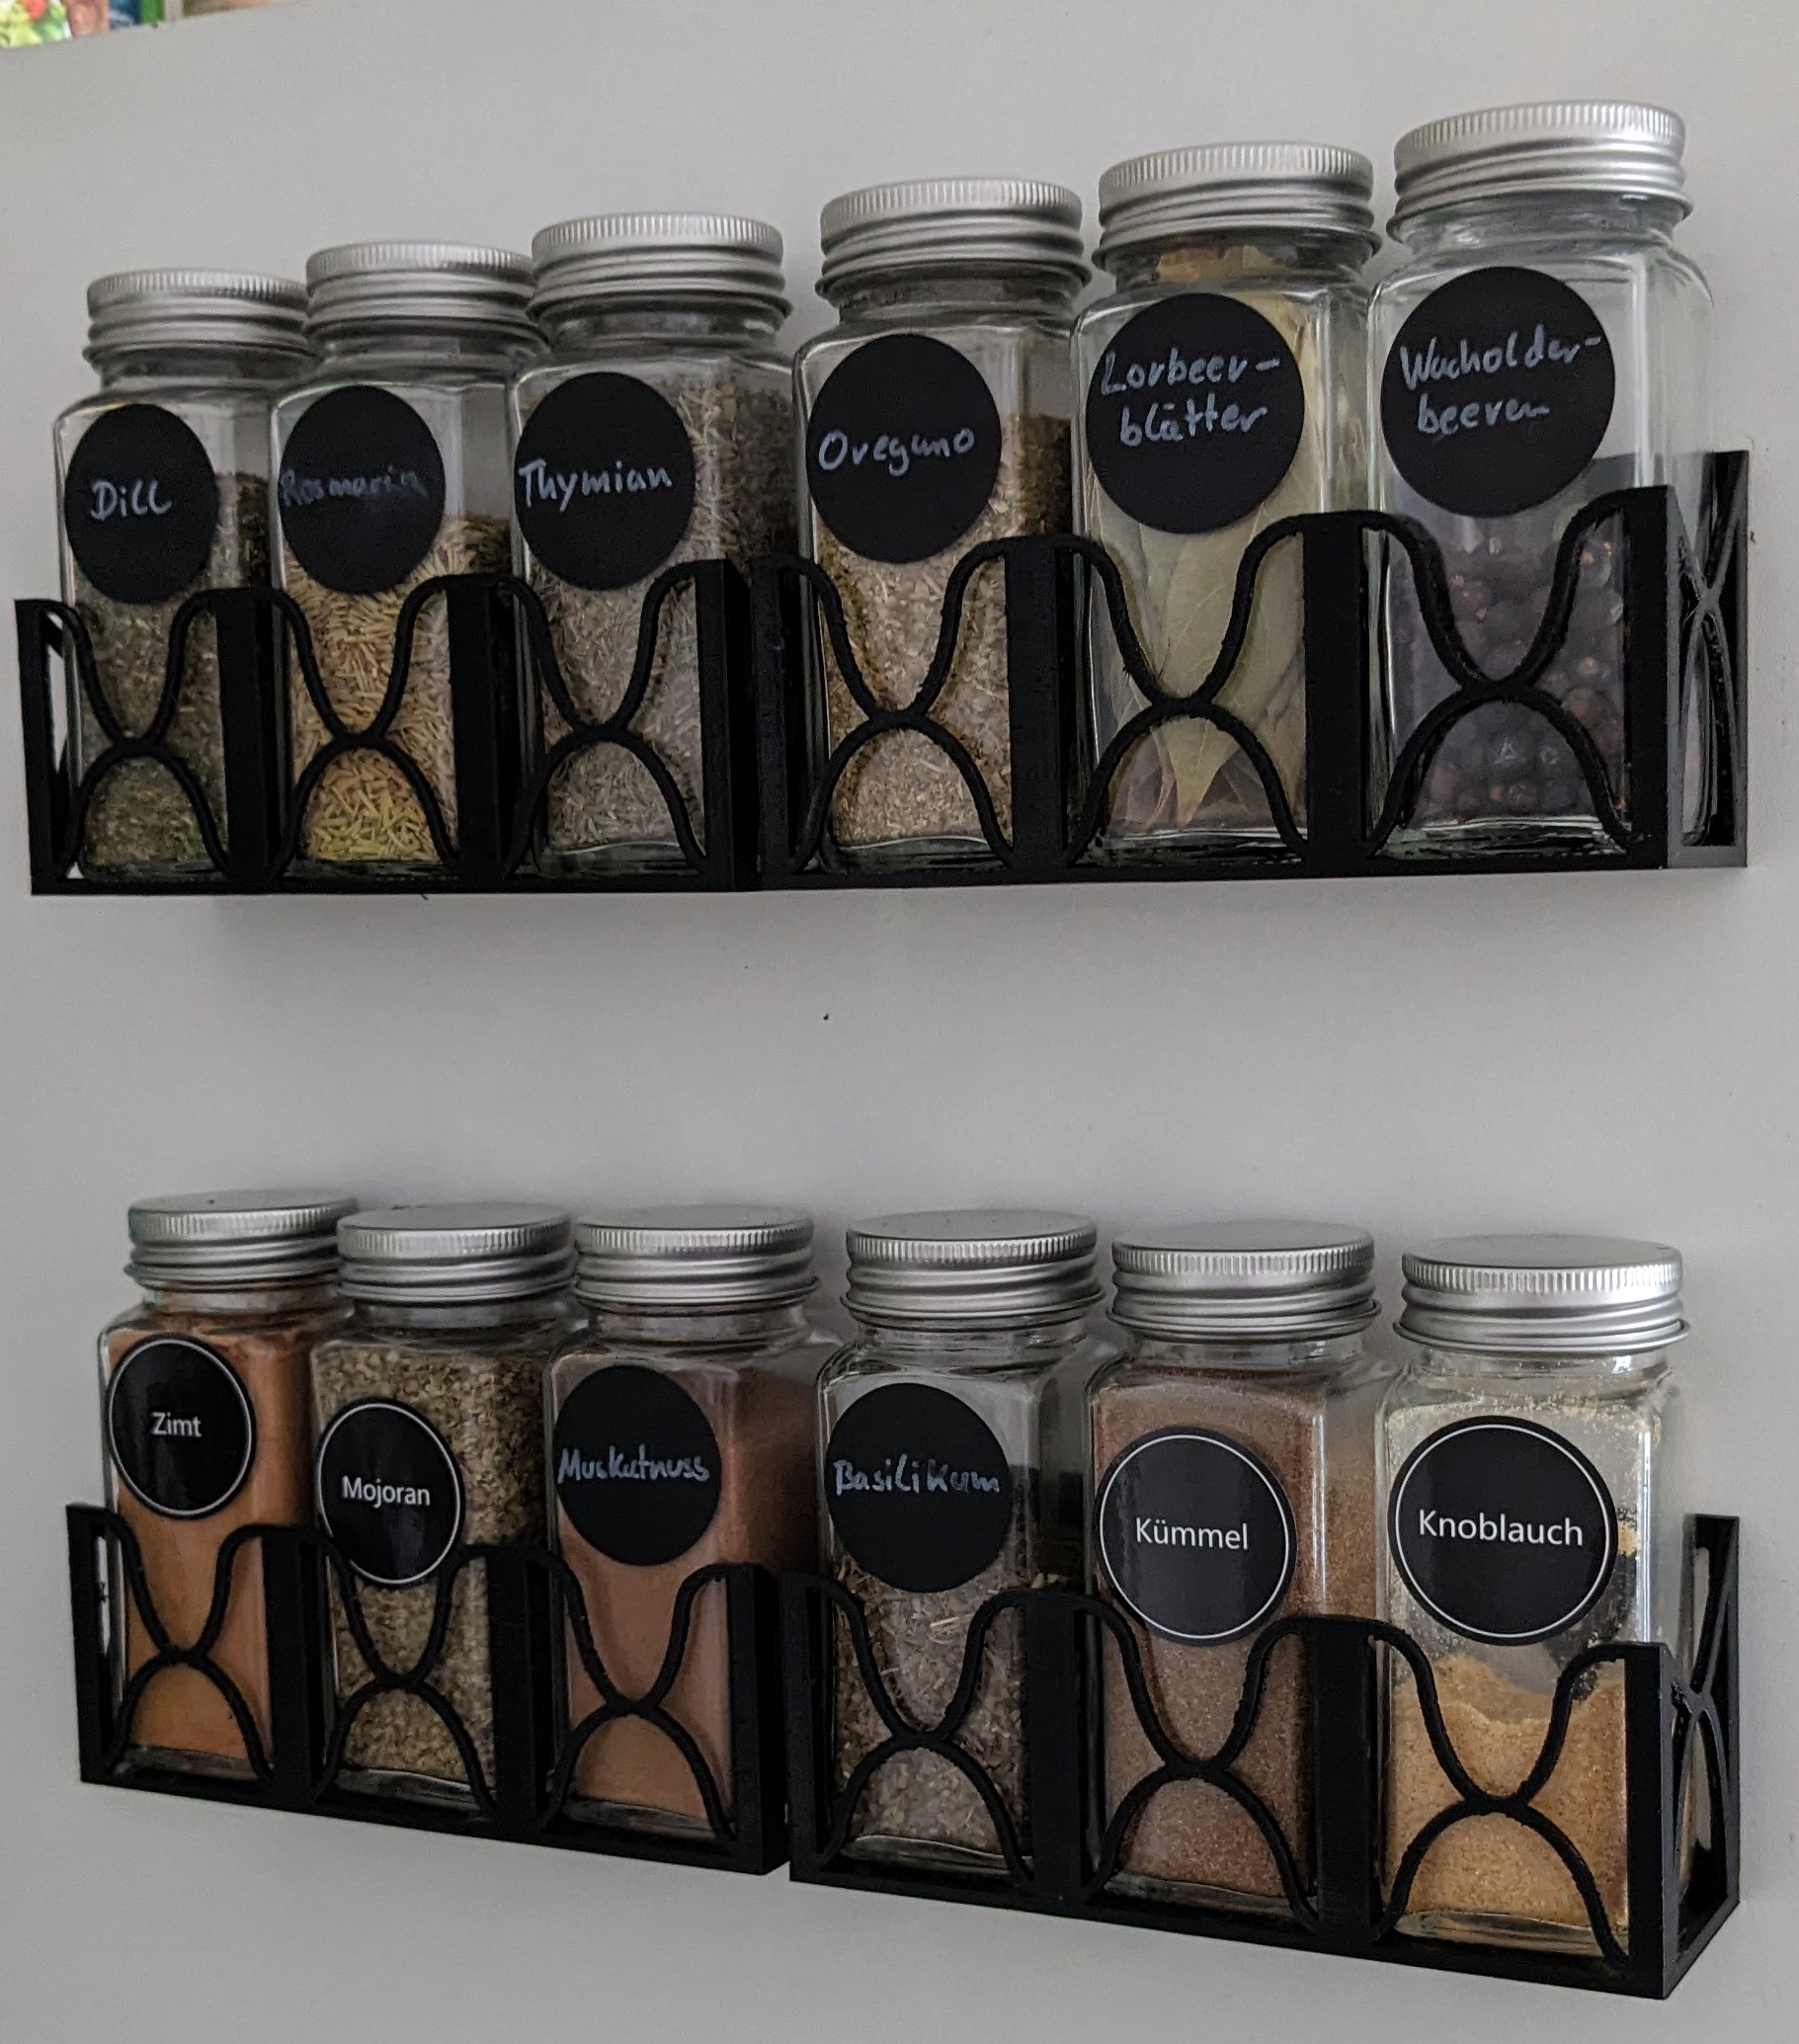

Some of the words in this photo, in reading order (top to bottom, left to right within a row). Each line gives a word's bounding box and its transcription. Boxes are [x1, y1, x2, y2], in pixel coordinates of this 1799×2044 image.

[1100, 347, 1281, 395] Lorbeer-
[1119, 394, 1268, 448] blätter
[1417, 392, 1551, 438] beeren
[818, 427, 976, 477] Oregano
[89, 478, 173, 522] Dill
[518, 457, 674, 513] Thymian
[149, 1411, 203, 1438] Zimt
[556, 1442, 710, 1485] Muskatnuss
[833, 1452, 1002, 1497] Basilikum
[341, 1475, 431, 1510] Mojoran
[1135, 1516, 1249, 1551] Kümmel
[1419, 1508, 1584, 1547] Knoblauch
